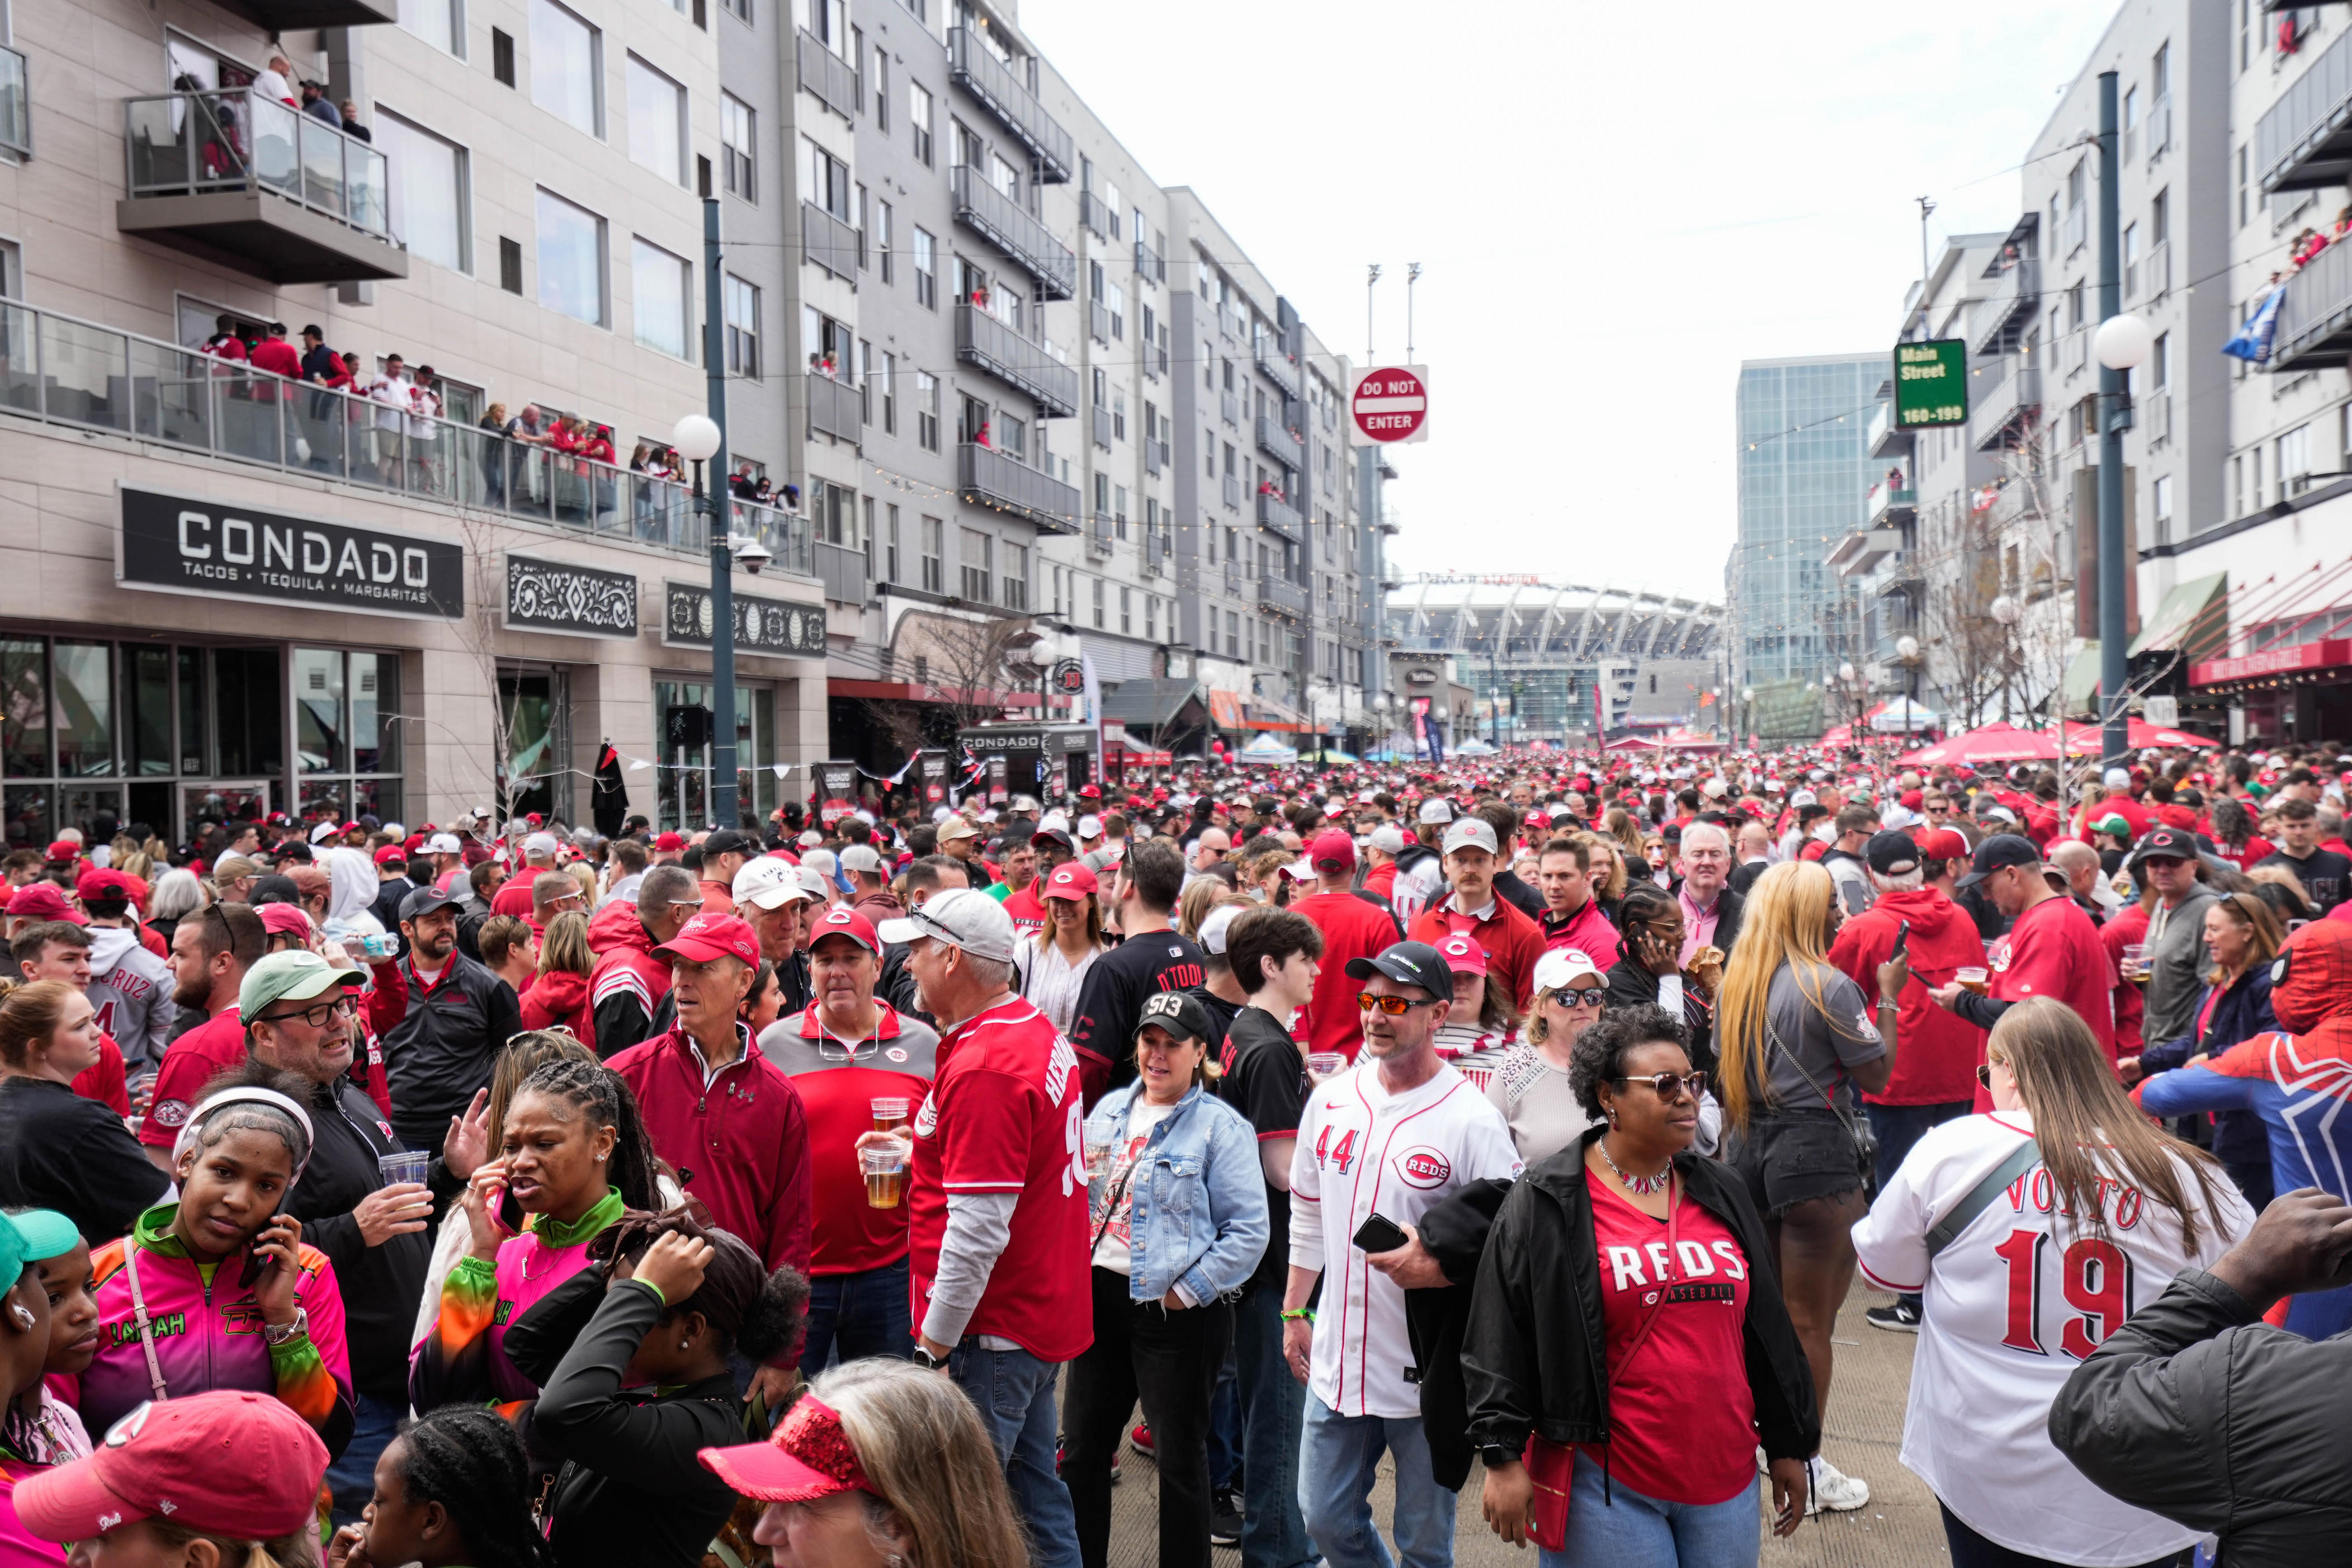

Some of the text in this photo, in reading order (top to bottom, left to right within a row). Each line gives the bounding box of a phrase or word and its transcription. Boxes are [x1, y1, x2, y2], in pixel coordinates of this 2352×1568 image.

[1900, 348, 1937, 363] Main
[1901, 363, 1945, 380] Street
[1363, 380, 1416, 395] DO NOT
[1367, 415, 1412, 429] ENTER
[1904, 405, 1962, 423] 160-199
[178, 511, 429, 588] CONDADO
[183, 561, 427, 603] TACOS TEQUILA MARGARITAS
[1484, 575, 1539, 585] STADIUM
[1064, 673, 1080, 688] JJ
[963, 737, 1038, 748] CONDADO
[1389, 952, 1422, 974] servicenow
[1147, 995, 1183, 1017] 513
[1316, 1125, 1359, 1175] 44
[1408, 1159, 1449, 1178] REDS
[1607, 1240, 1745, 1293] REDS
[1670, 1287, 1732, 1300] ASEBALL
[1992, 1229, 2134, 1362] 19
[100, 1512, 122, 1532] Reds
